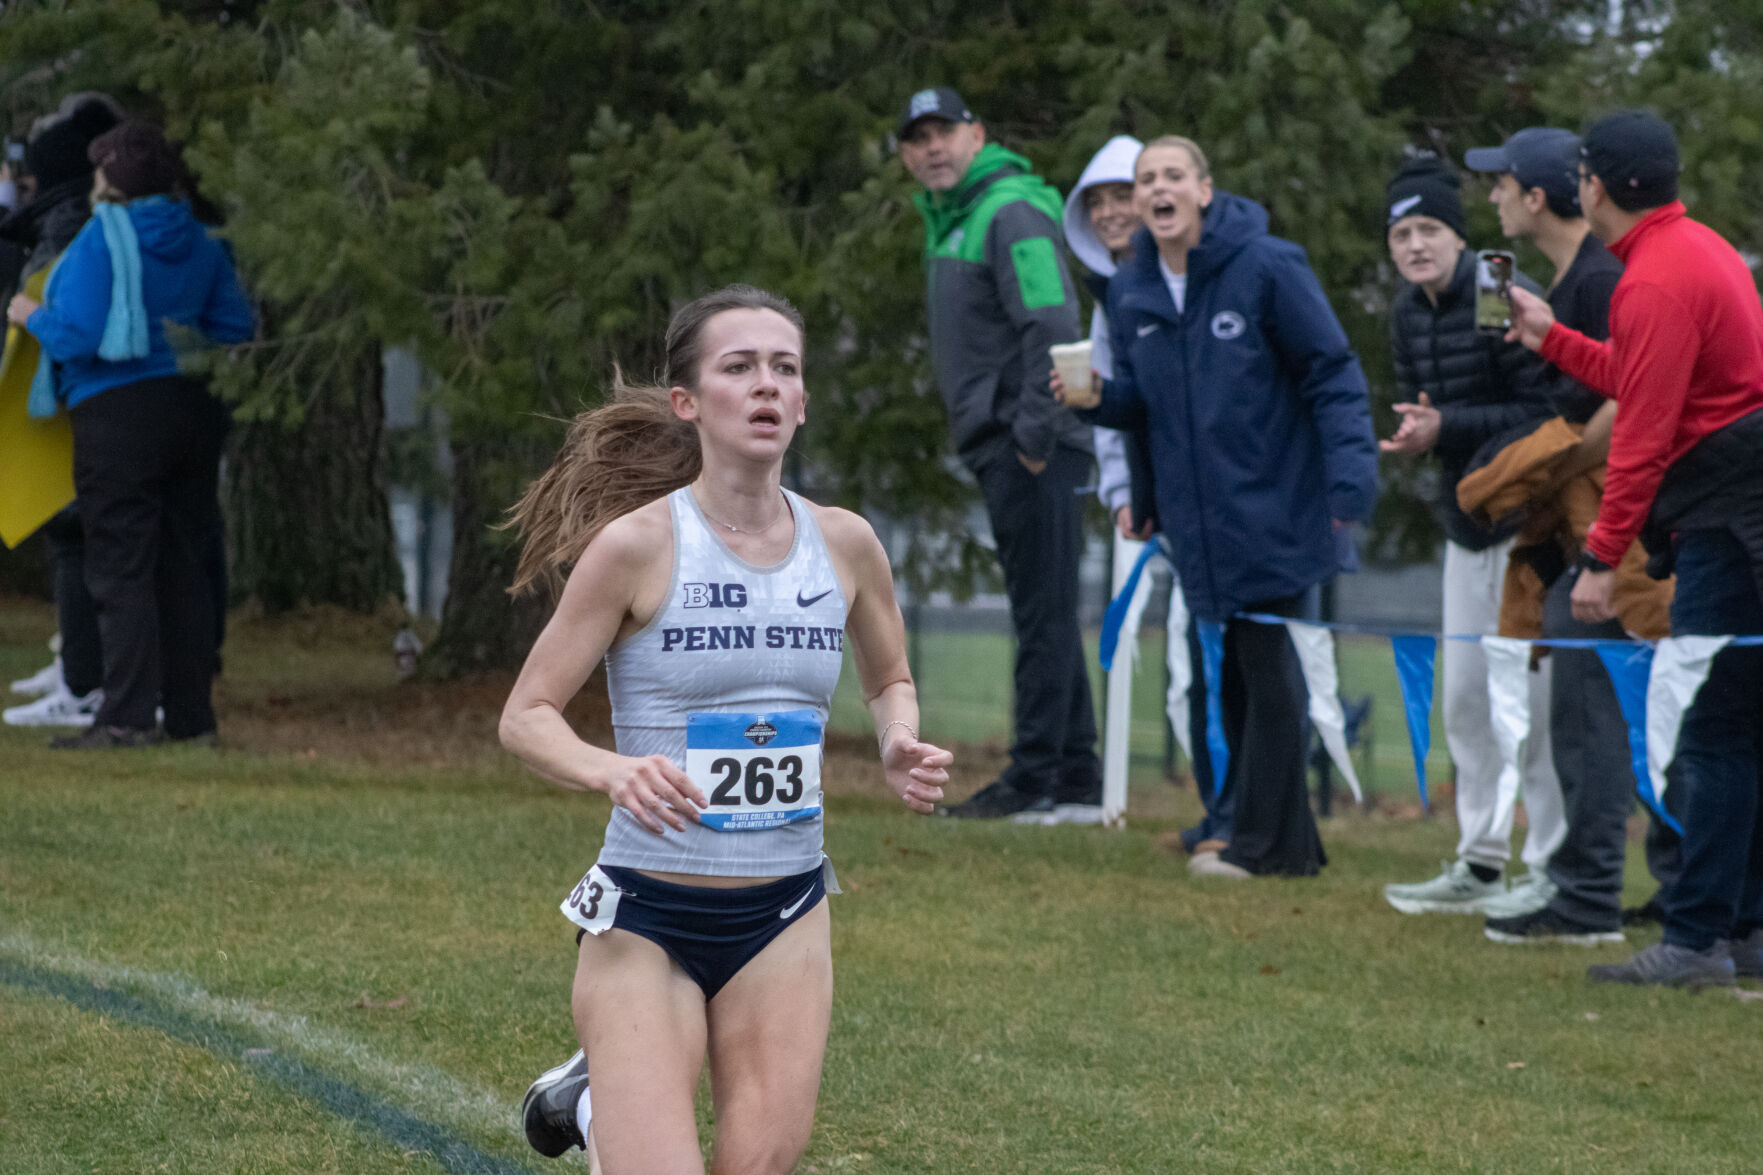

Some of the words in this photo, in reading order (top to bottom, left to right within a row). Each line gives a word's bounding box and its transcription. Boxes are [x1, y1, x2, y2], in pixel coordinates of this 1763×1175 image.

[662, 626, 755, 651] PENN
[710, 755, 803, 805] 263
[723, 820, 763, 828] MID-ATLANTIC
[750, 812, 775, 820] COLLEGE,
[777, 811, 785, 819] PA
[567, 873, 604, 919] 63
